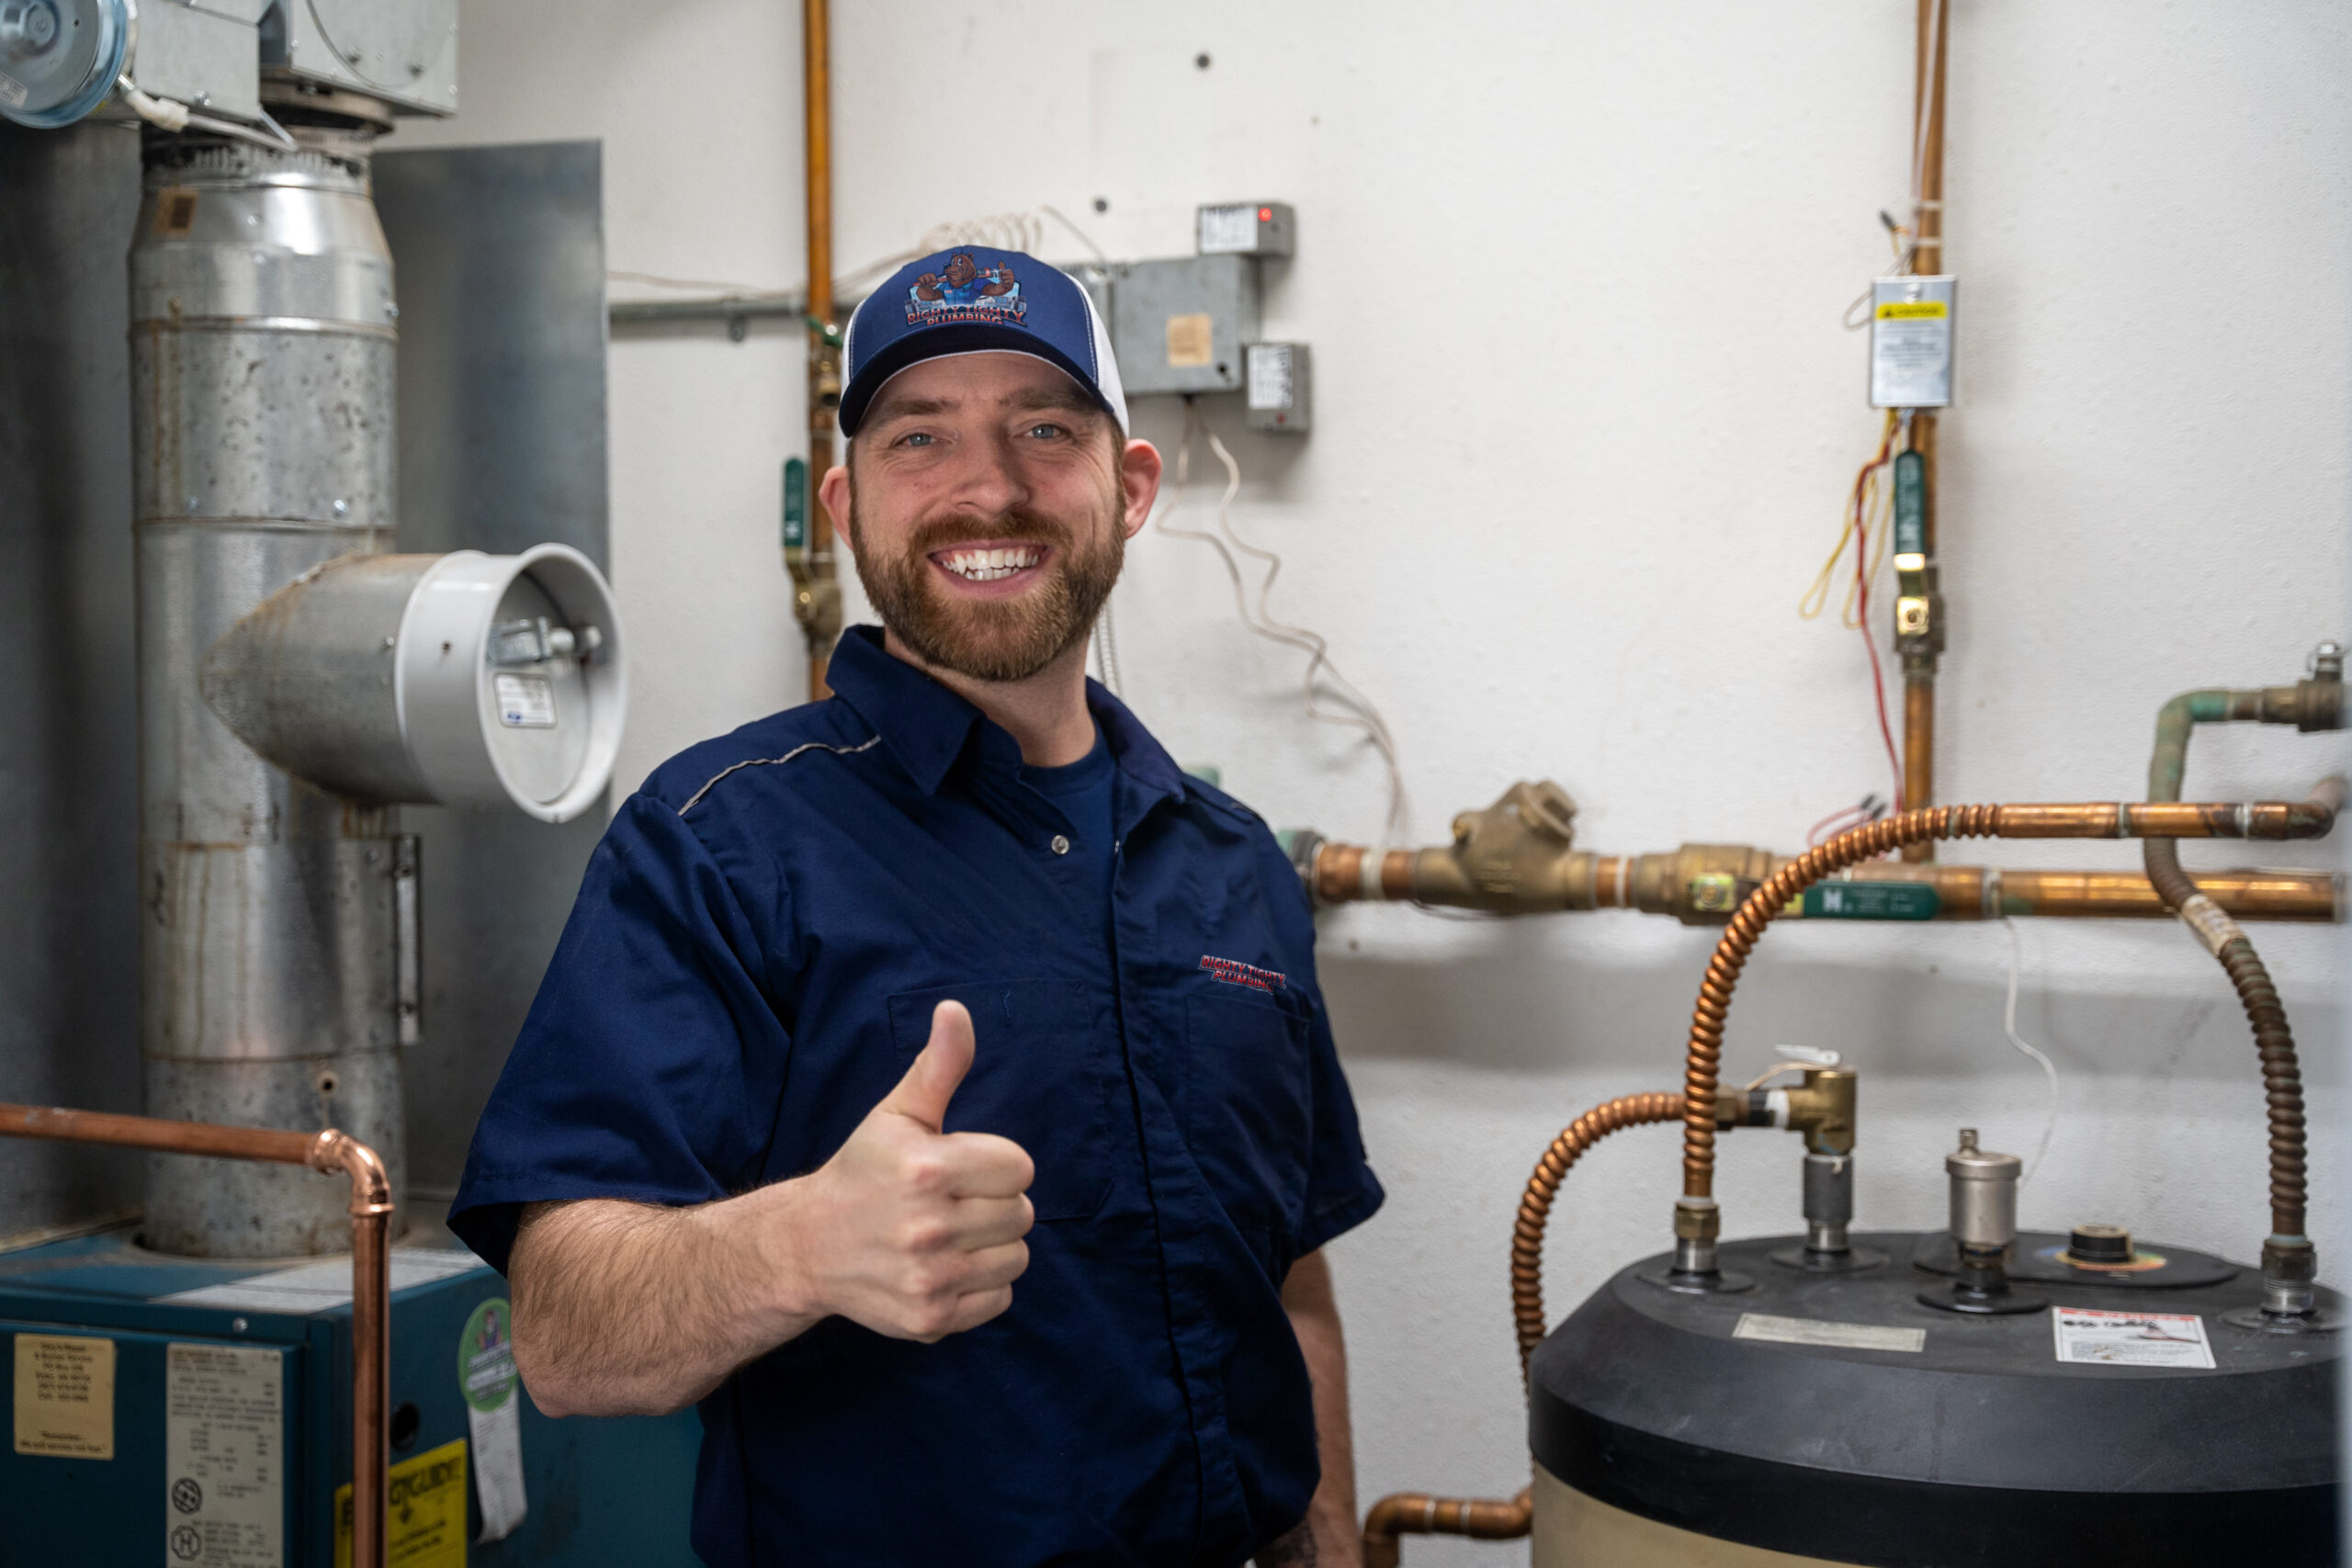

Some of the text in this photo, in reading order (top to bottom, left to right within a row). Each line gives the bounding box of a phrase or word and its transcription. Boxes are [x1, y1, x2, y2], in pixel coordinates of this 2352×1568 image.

[907, 305, 1024, 323] RIGHTY TIGHTY
[927, 313, 1003, 326] PLUMBING
[1201, 955, 1285, 987] RIGHTY TIGHTY
[1213, 970, 1273, 992] PLUMBING
